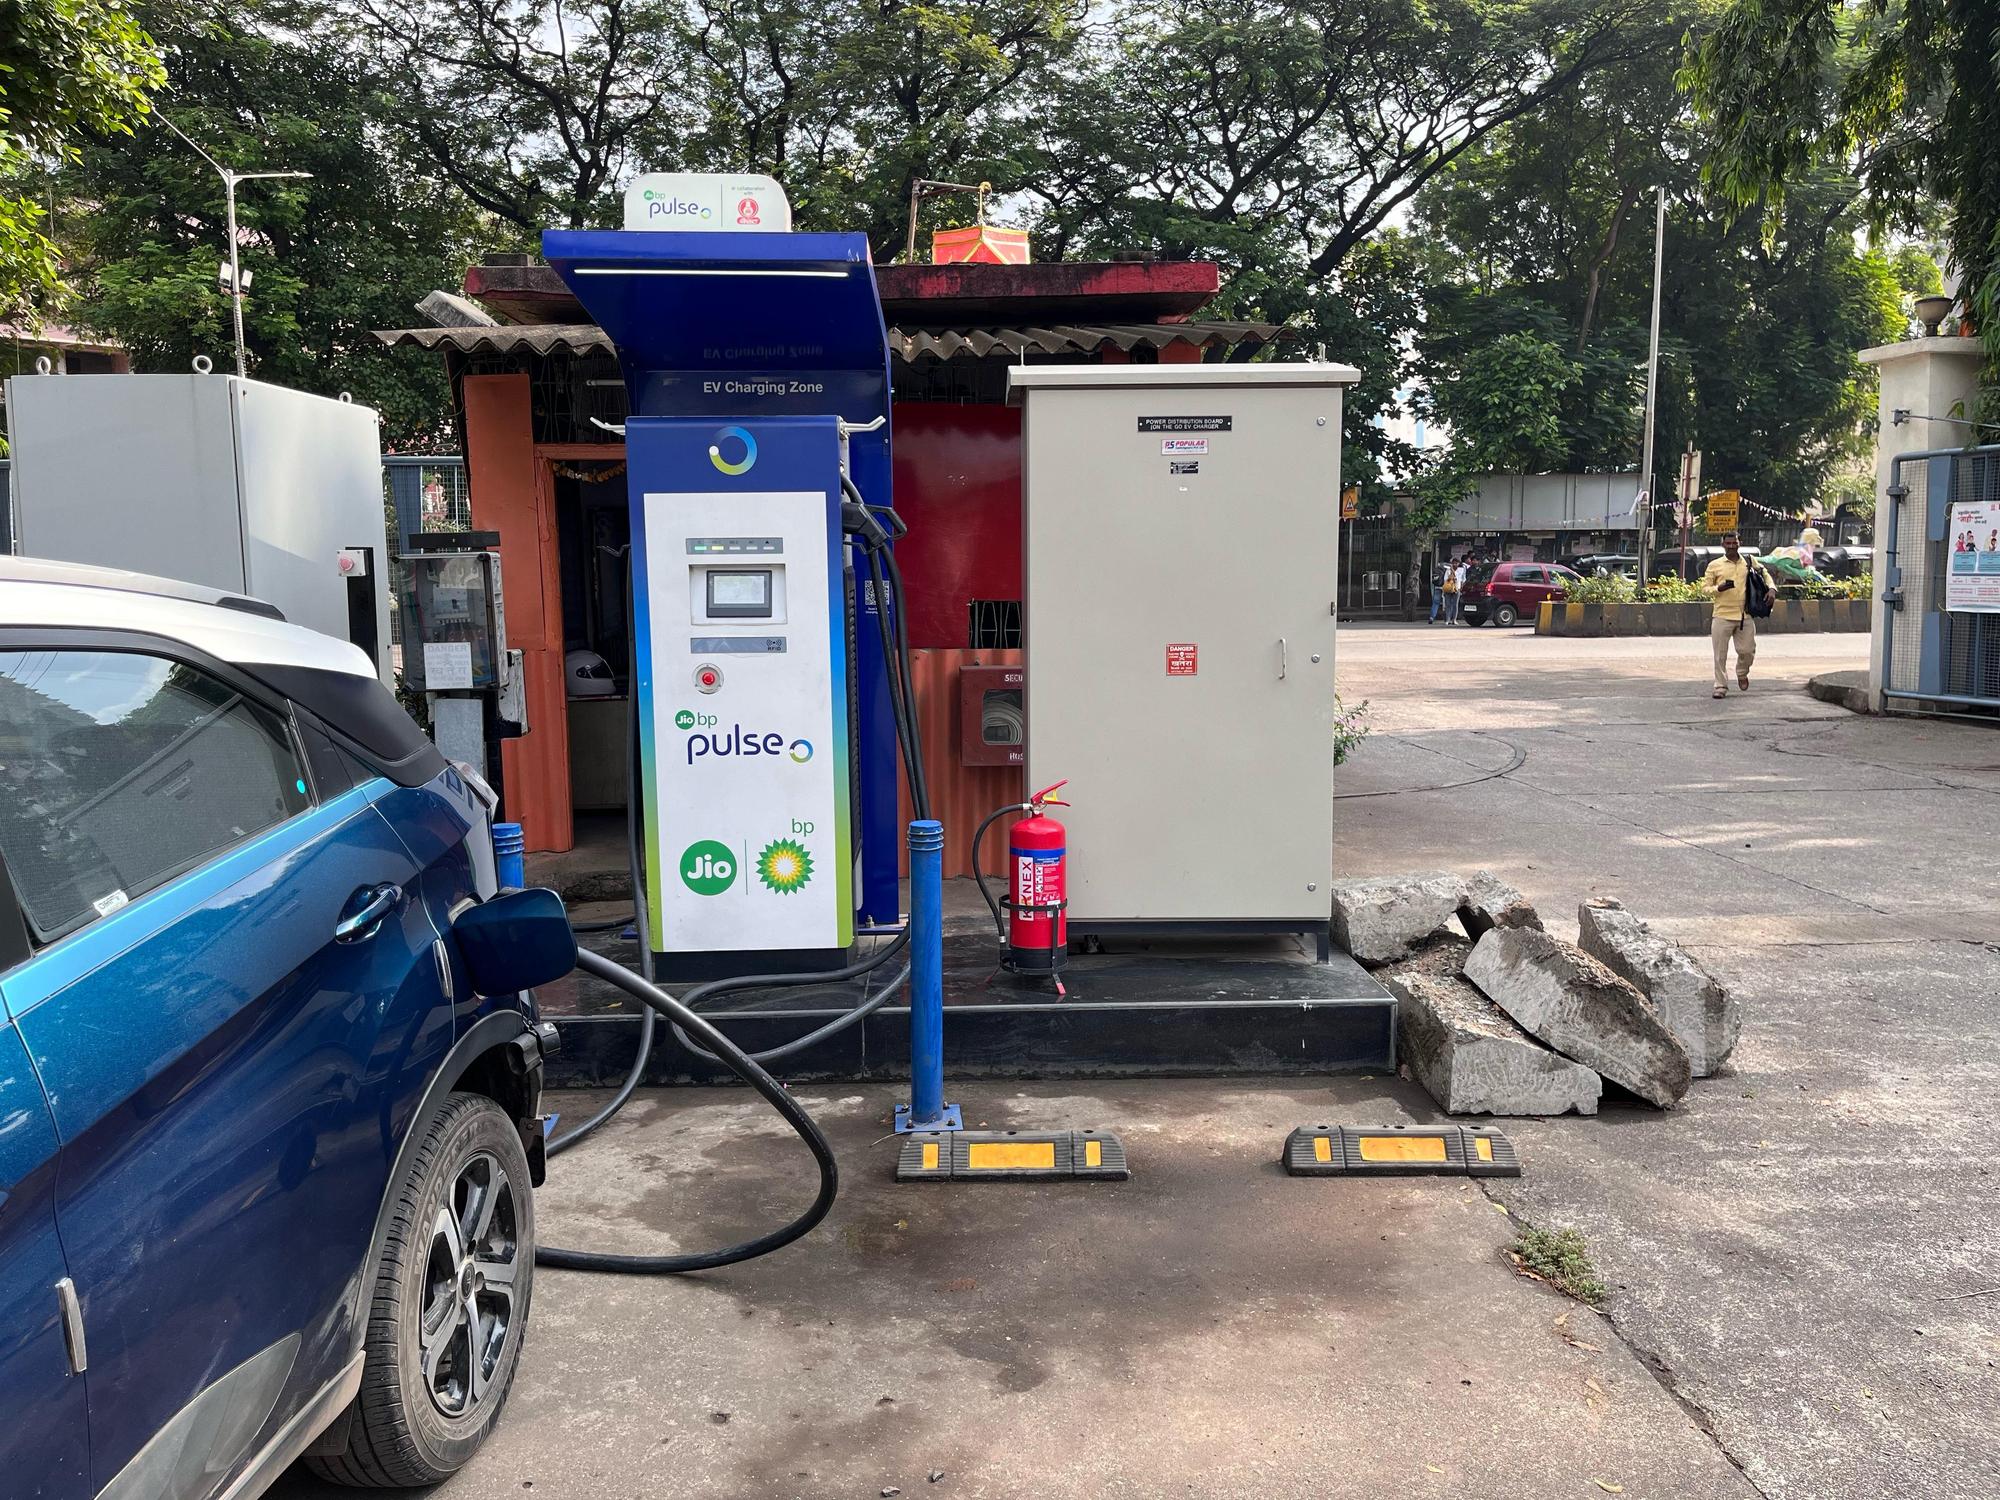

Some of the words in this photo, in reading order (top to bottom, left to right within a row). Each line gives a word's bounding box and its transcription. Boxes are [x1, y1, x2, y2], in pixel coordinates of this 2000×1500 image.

[655, 191, 666, 201] bp
[649, 197, 699, 219] pulse
[703, 382, 721, 393] EV
[725, 381, 785, 395] Charging
[789, 381, 823, 393] Zone
[428, 644, 467, 653] DANGER
[677, 715, 694, 725] Jio
[697, 712, 718, 729] bp
[687, 723, 784, 765] pulse
[791, 818, 815, 837] bp
[687, 853, 732, 880] Jio
